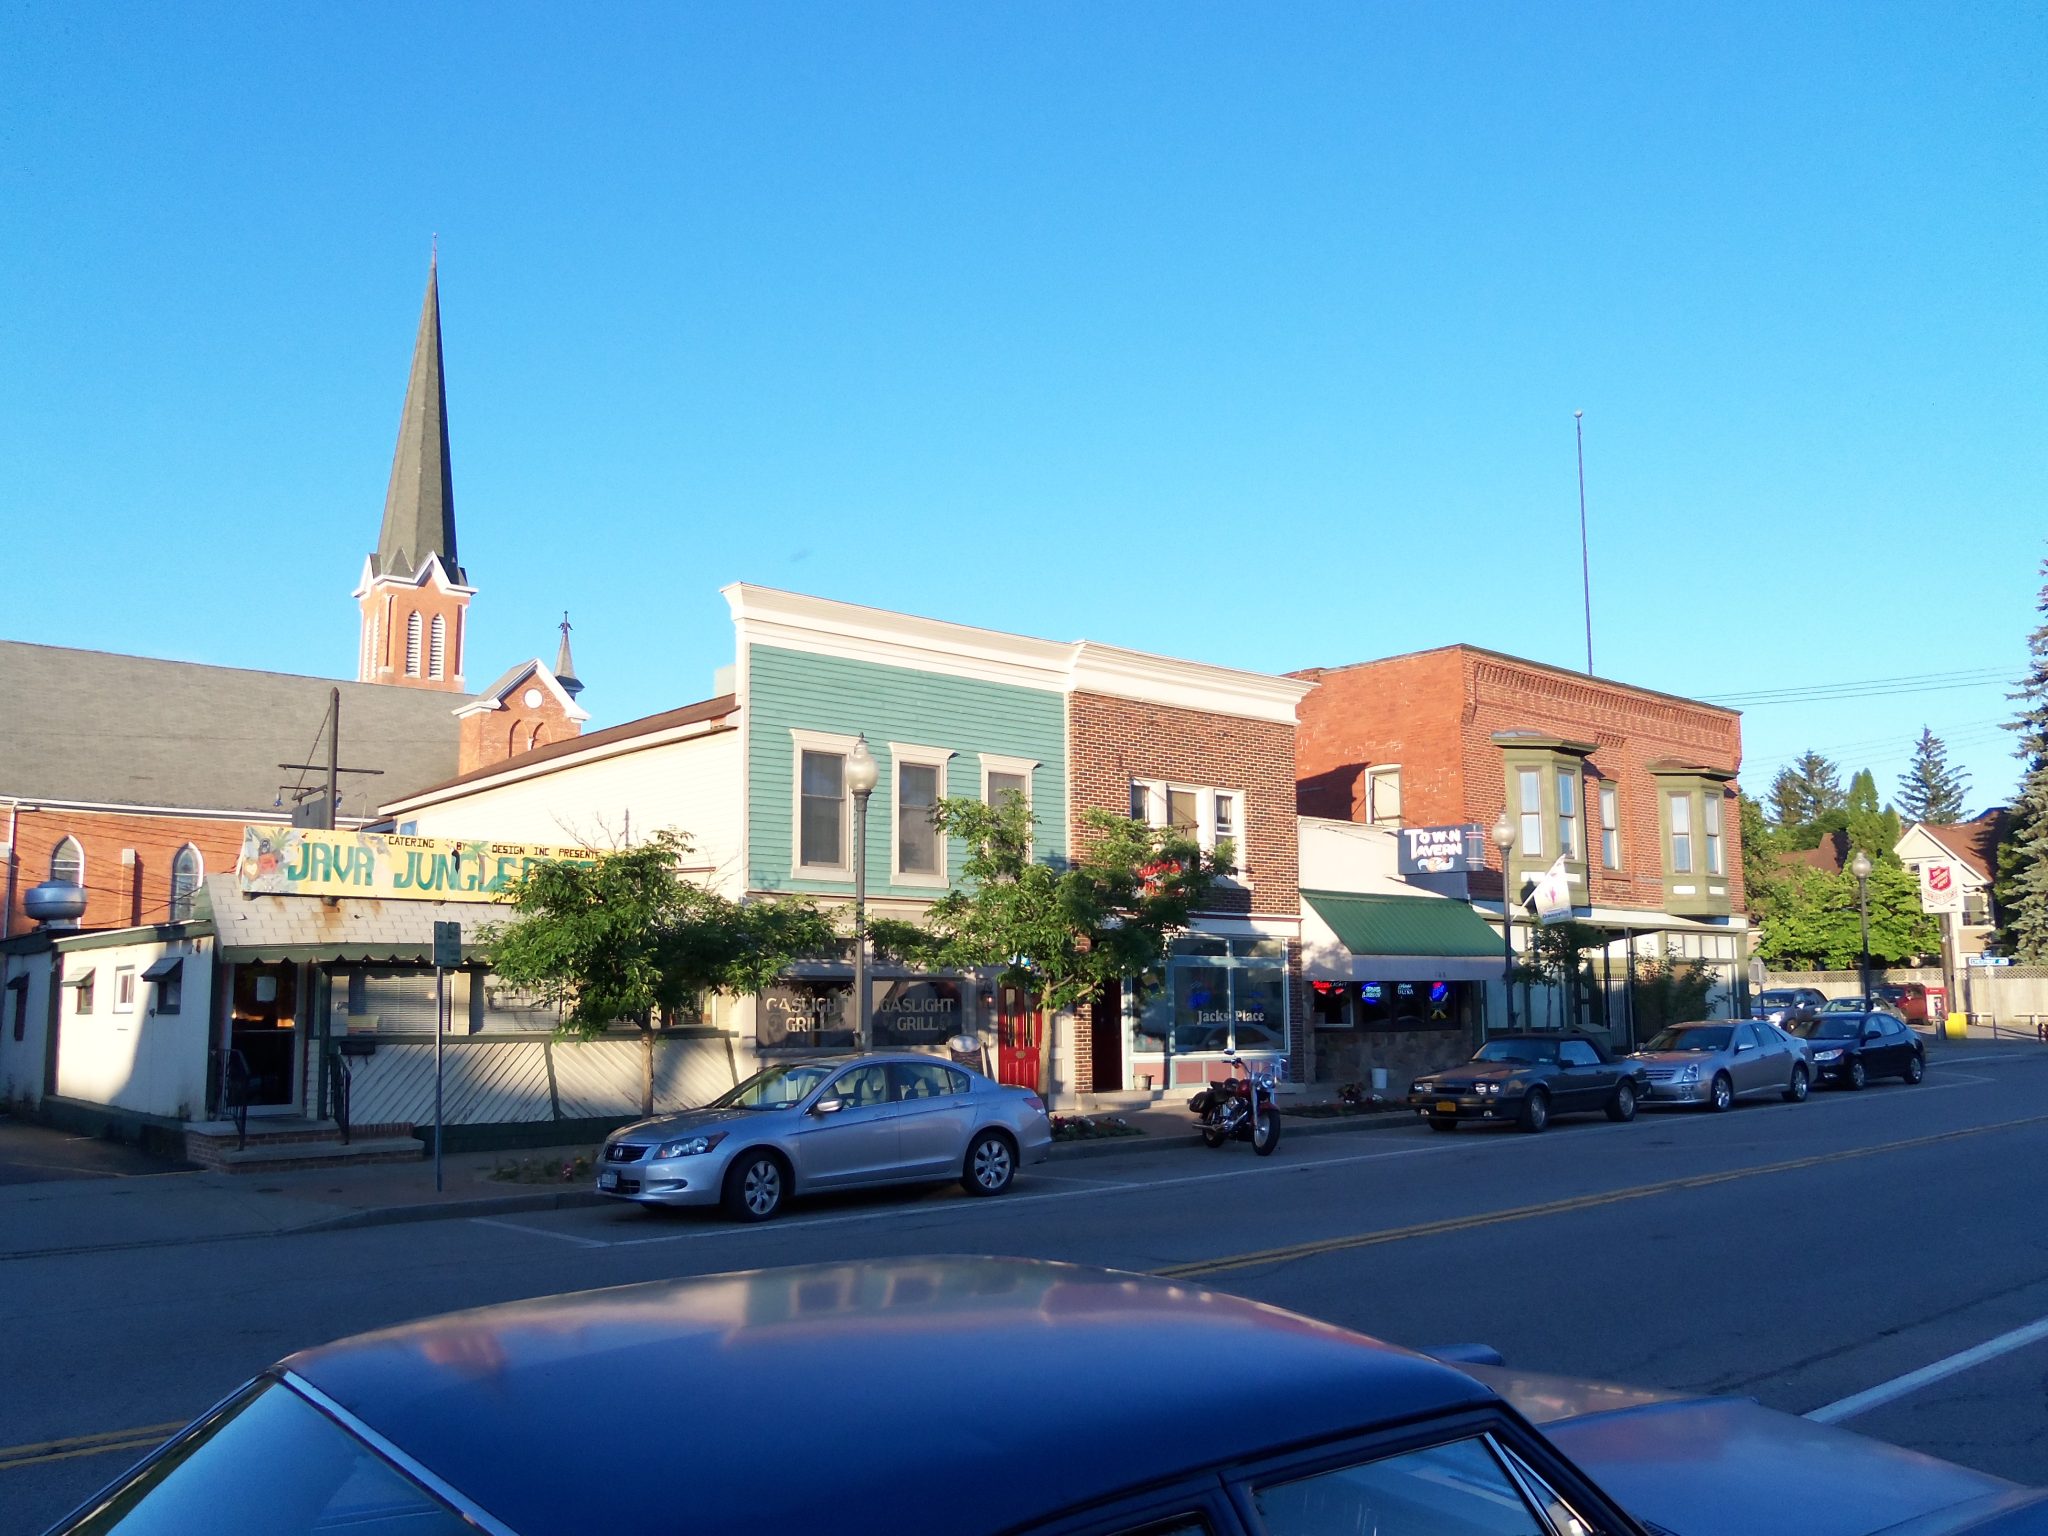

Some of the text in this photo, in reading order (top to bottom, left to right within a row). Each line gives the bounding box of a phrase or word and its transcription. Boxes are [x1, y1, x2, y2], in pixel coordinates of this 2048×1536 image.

[388, 835, 601, 859] CATERING BY DESIGN INC PRESENTS
[1404, 828, 1461, 850] TOWN
[287, 842, 375, 886] JAVA
[880, 998, 955, 1014] GASLIGHT
[896, 1016, 939, 1031] GRILL
[1234, 1009, 1265, 1022] Place
[785, 1016, 832, 1033] GRILL
